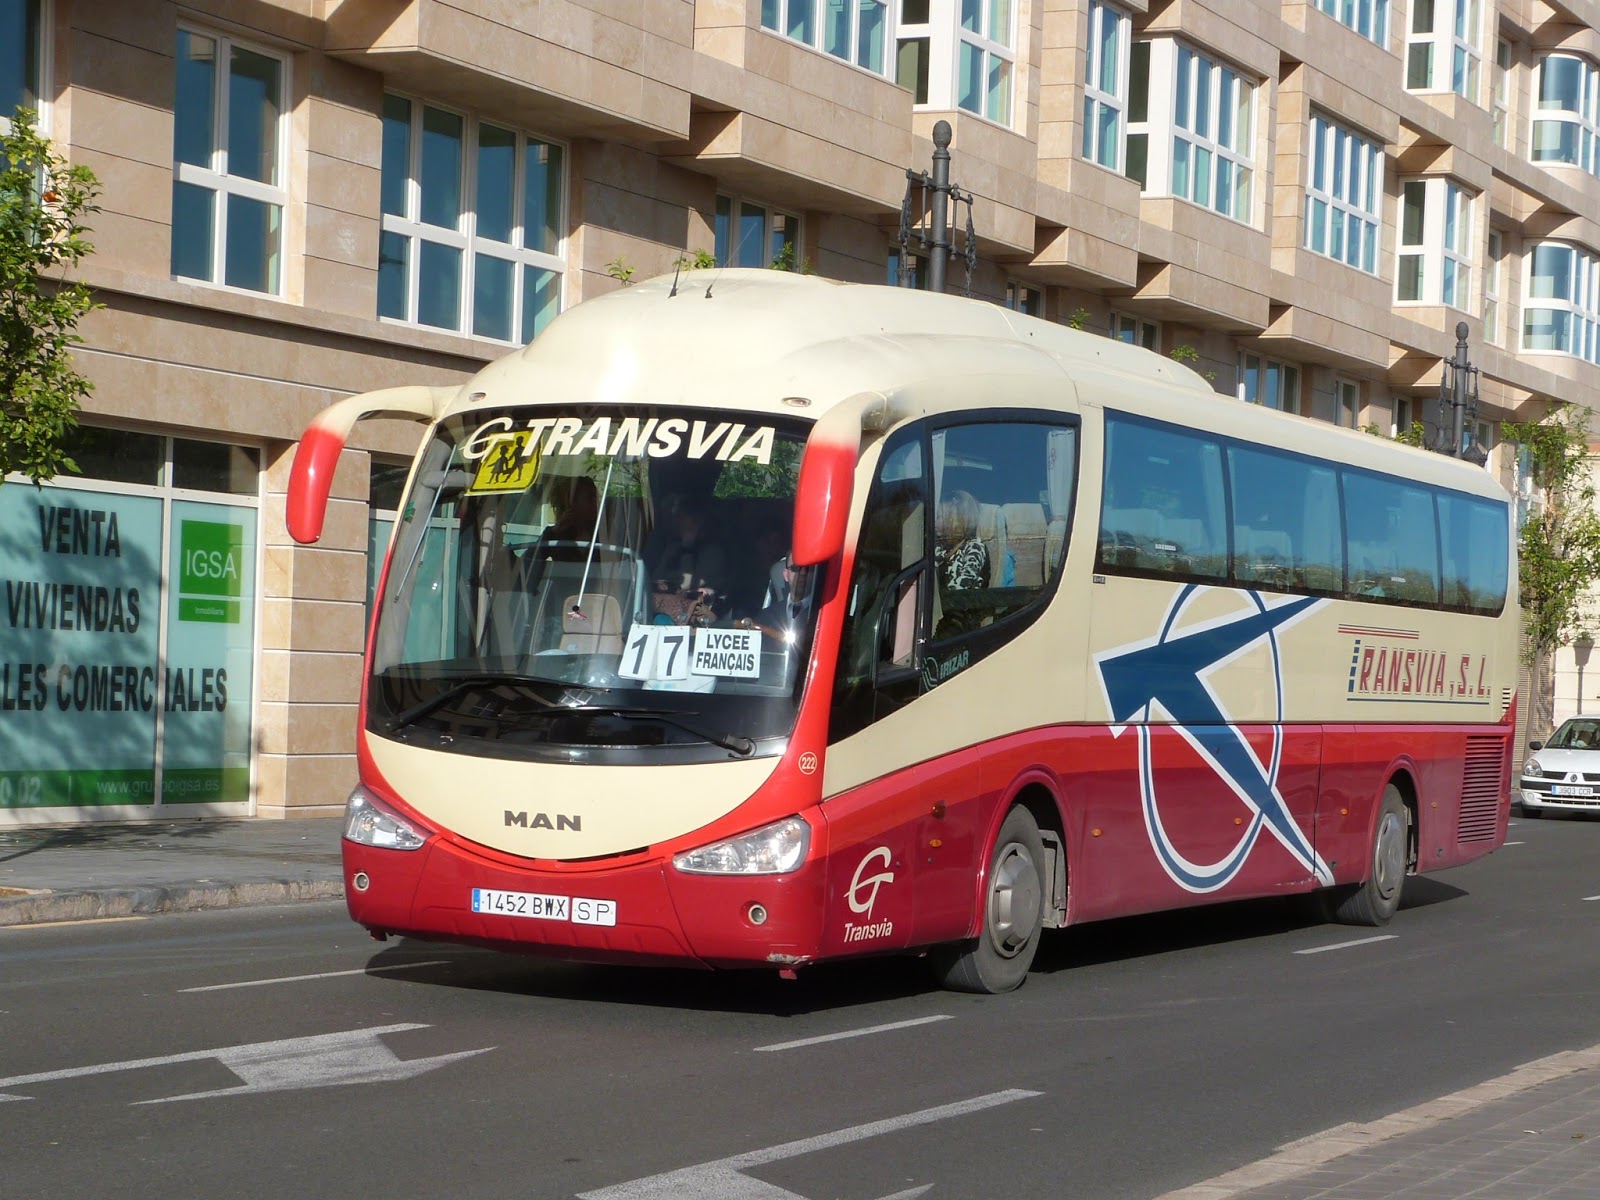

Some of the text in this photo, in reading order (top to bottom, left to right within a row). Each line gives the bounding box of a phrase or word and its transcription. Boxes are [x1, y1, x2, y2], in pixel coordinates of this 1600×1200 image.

[521, 416, 776, 465] TRANSVIA
[38, 505, 121, 557] VENTA
[186, 549, 237, 579] IGSA
[6, 580, 140, 634] VIVIENDAS
[706, 633, 750, 651] LYCEE
[695, 652, 755, 676] FRANÇAIS
[56, 664, 228, 713] COMERCIALES
[801, 756, 816, 770] 222
[1558, 786, 1576, 795] 3903
[504, 810, 582, 832] MAN
[486, 892, 527, 914] 1452
[532, 896, 566, 917] BWX
[843, 918, 893, 943] Transvia
